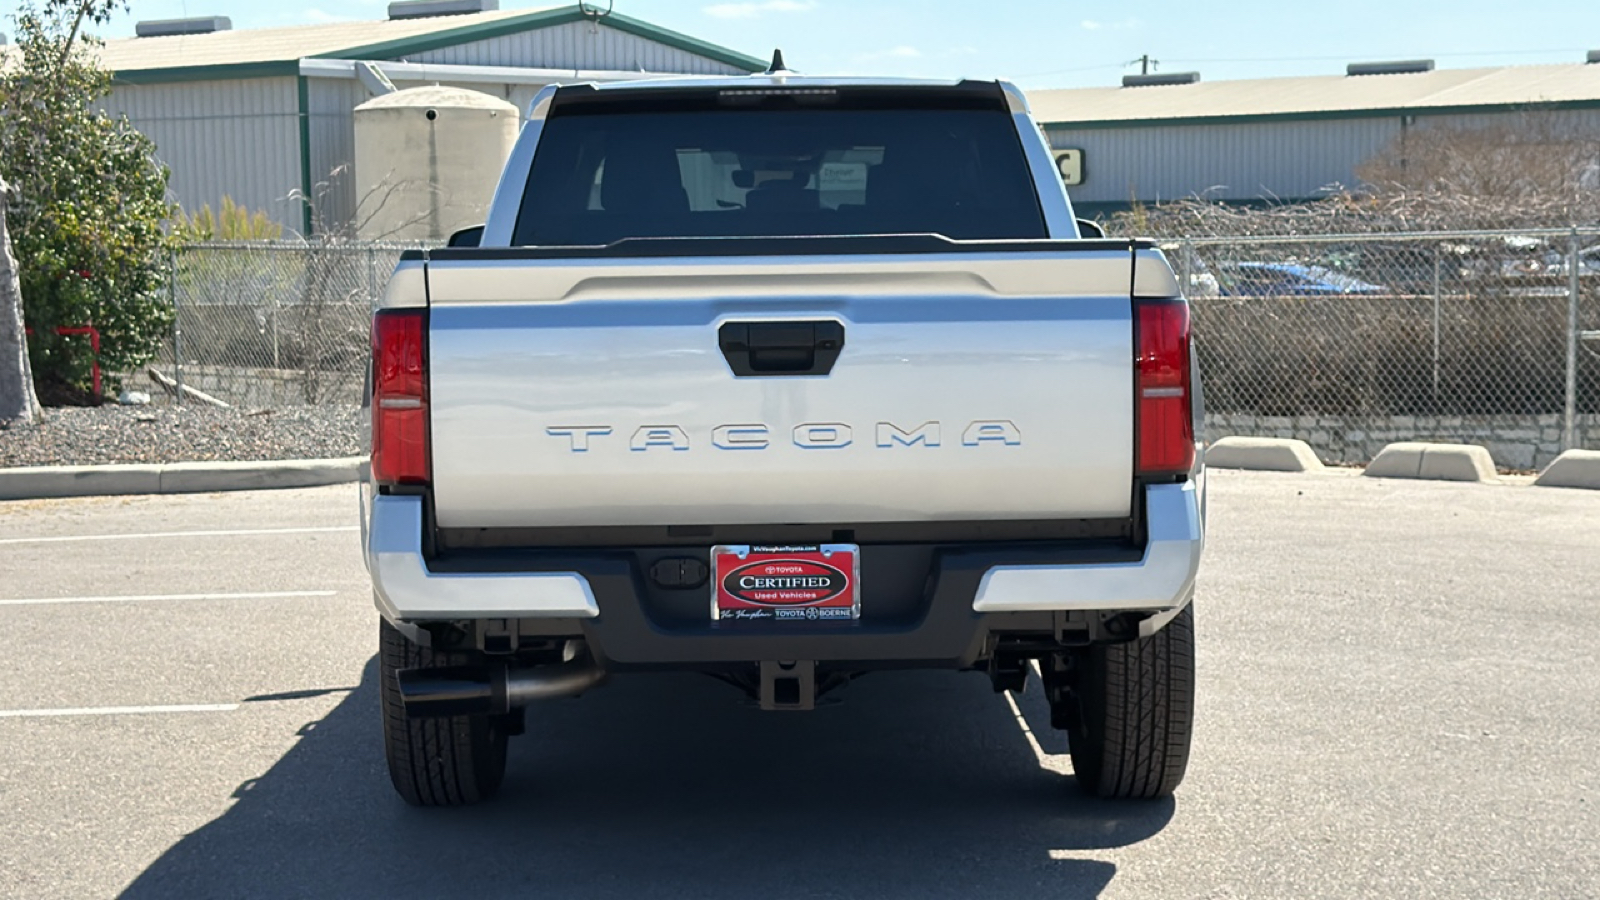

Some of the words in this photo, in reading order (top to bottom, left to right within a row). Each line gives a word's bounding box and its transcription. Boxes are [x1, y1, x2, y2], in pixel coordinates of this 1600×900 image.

[1055, 153, 1070, 180] C
[545, 419, 1021, 451] TACOMA
[754, 591, 777, 599] Used
[779, 591, 817, 599] Vehicles
[819, 609, 851, 617] BOERNE
